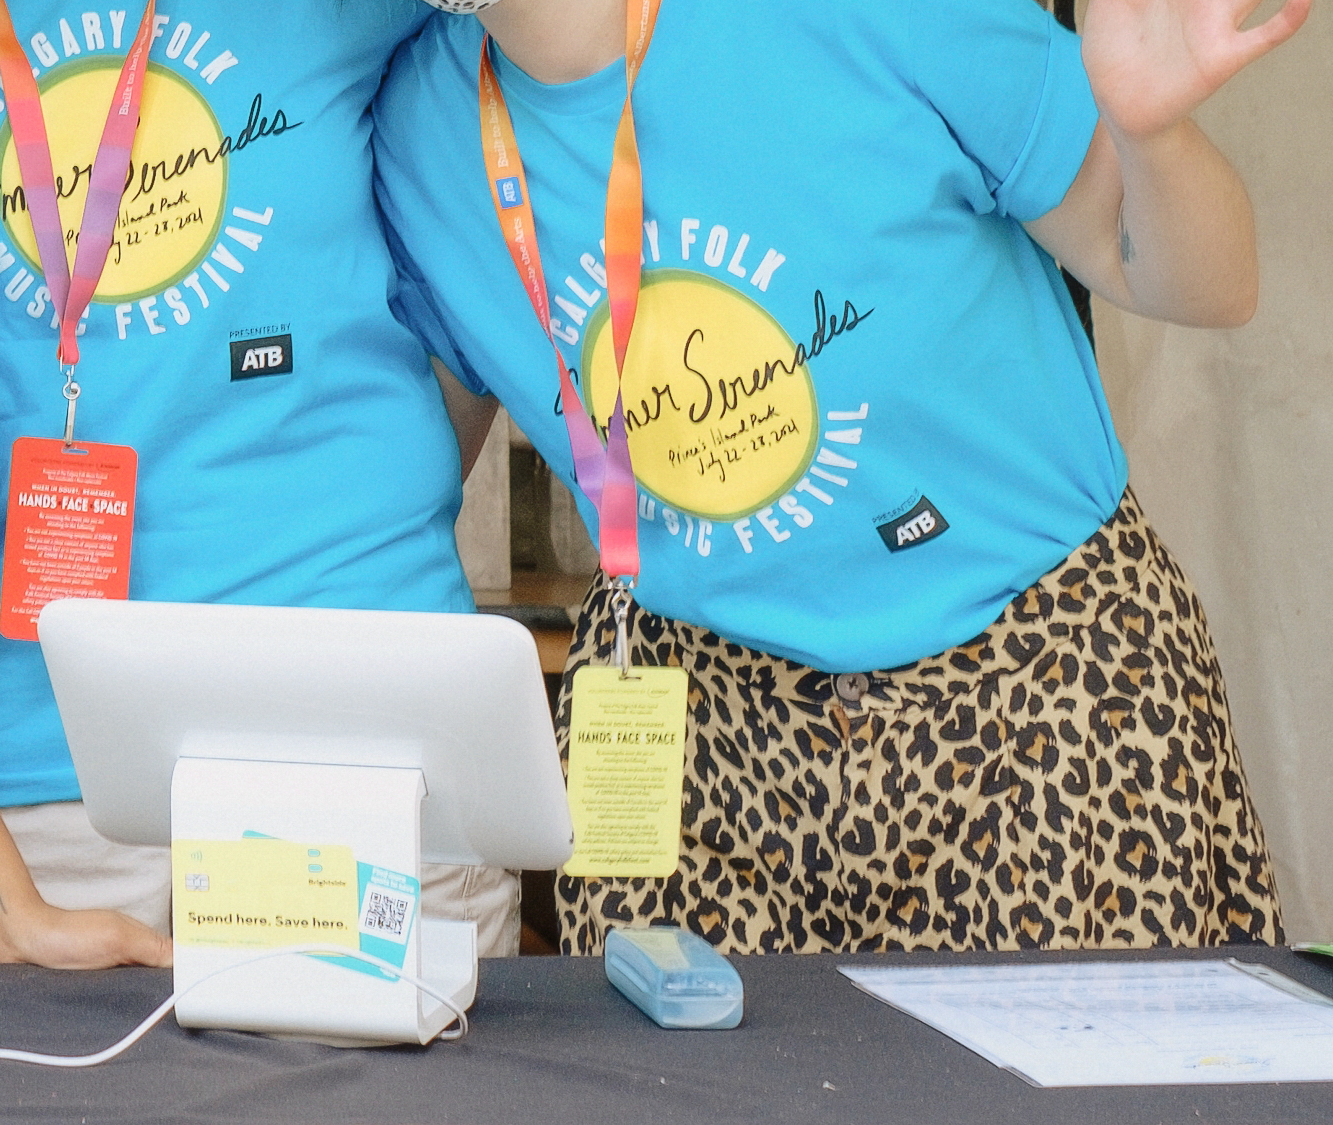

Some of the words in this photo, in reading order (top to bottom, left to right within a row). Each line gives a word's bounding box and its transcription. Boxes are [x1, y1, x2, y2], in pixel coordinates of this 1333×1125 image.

[150, 13, 239, 86] FOLK
[121, 93, 304, 203] erenades
[502, 181, 517, 203] ATB
[116, 206, 274, 341] FESTIVAL
[550, 220, 660, 346] CALGY
[681, 217, 787, 293] FOLK
[241, 345, 283, 372] ATB
[688, 289, 875, 424] Serenades
[18, 492, 57, 510] HANDS
[61, 496, 88, 512] FACE
[92, 501, 128, 516] SPACE
[638, 495, 713, 557] USIC
[733, 403, 869, 554] FESTIVAL
[896, 509, 937, 546] ATB
[577, 730, 612, 745] HANDS
[616, 731, 640, 745] FACE
[645, 731, 676, 746] SPACE
[188, 911, 233, 928] Spend
[236, 913, 271, 926] here.
[275, 914, 309, 928] Save
[312, 916, 349, 930] here.
